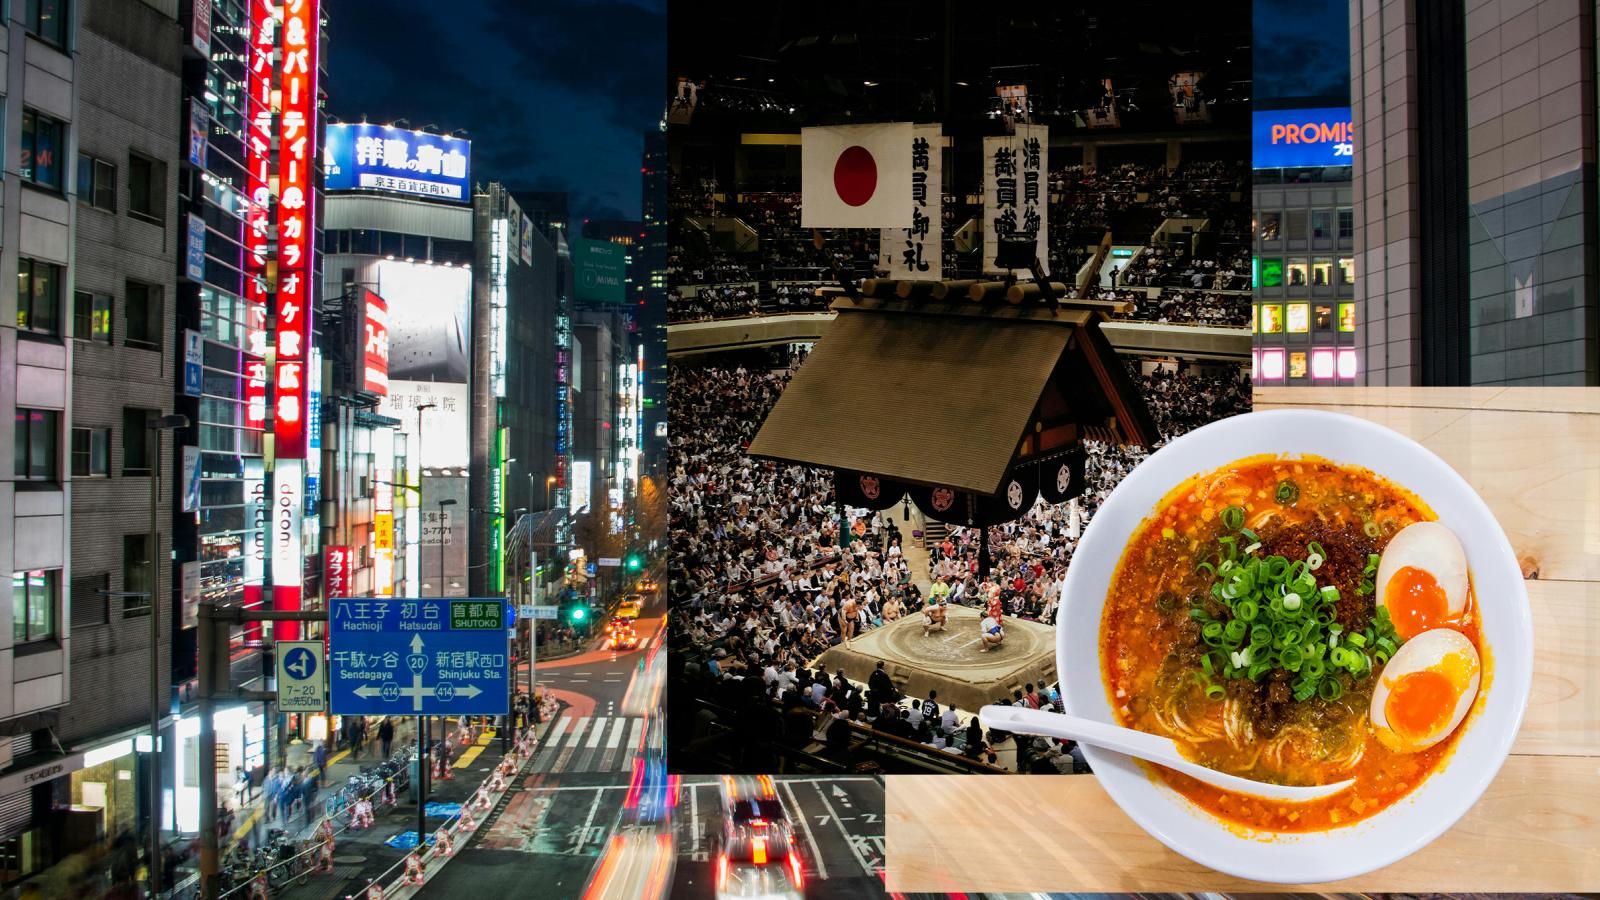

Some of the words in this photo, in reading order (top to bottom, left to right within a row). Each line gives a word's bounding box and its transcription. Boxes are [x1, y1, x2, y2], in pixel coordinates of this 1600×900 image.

[280, 484, 294, 560] docomo
[329, 549, 345, 598] カラオケ
[335, 602, 391, 619] 八王子
[400, 602, 440, 619] 初台
[452, 603, 499, 618] 首都高
[343, 620, 383, 632] Hachioji
[400, 620, 441, 631] Hatsudai
[455, 619, 497, 628] SHUTOKO
[411, 657, 424, 669] 20
[436, 651, 504, 668] 新宿駅西口
[340, 669, 393, 680] Sendagaya
[438, 669, 481, 680] Shinjuku
[484, 669, 502, 679] Sta.
[383, 687, 398, 697] 414
[437, 687, 452, 697] 414
